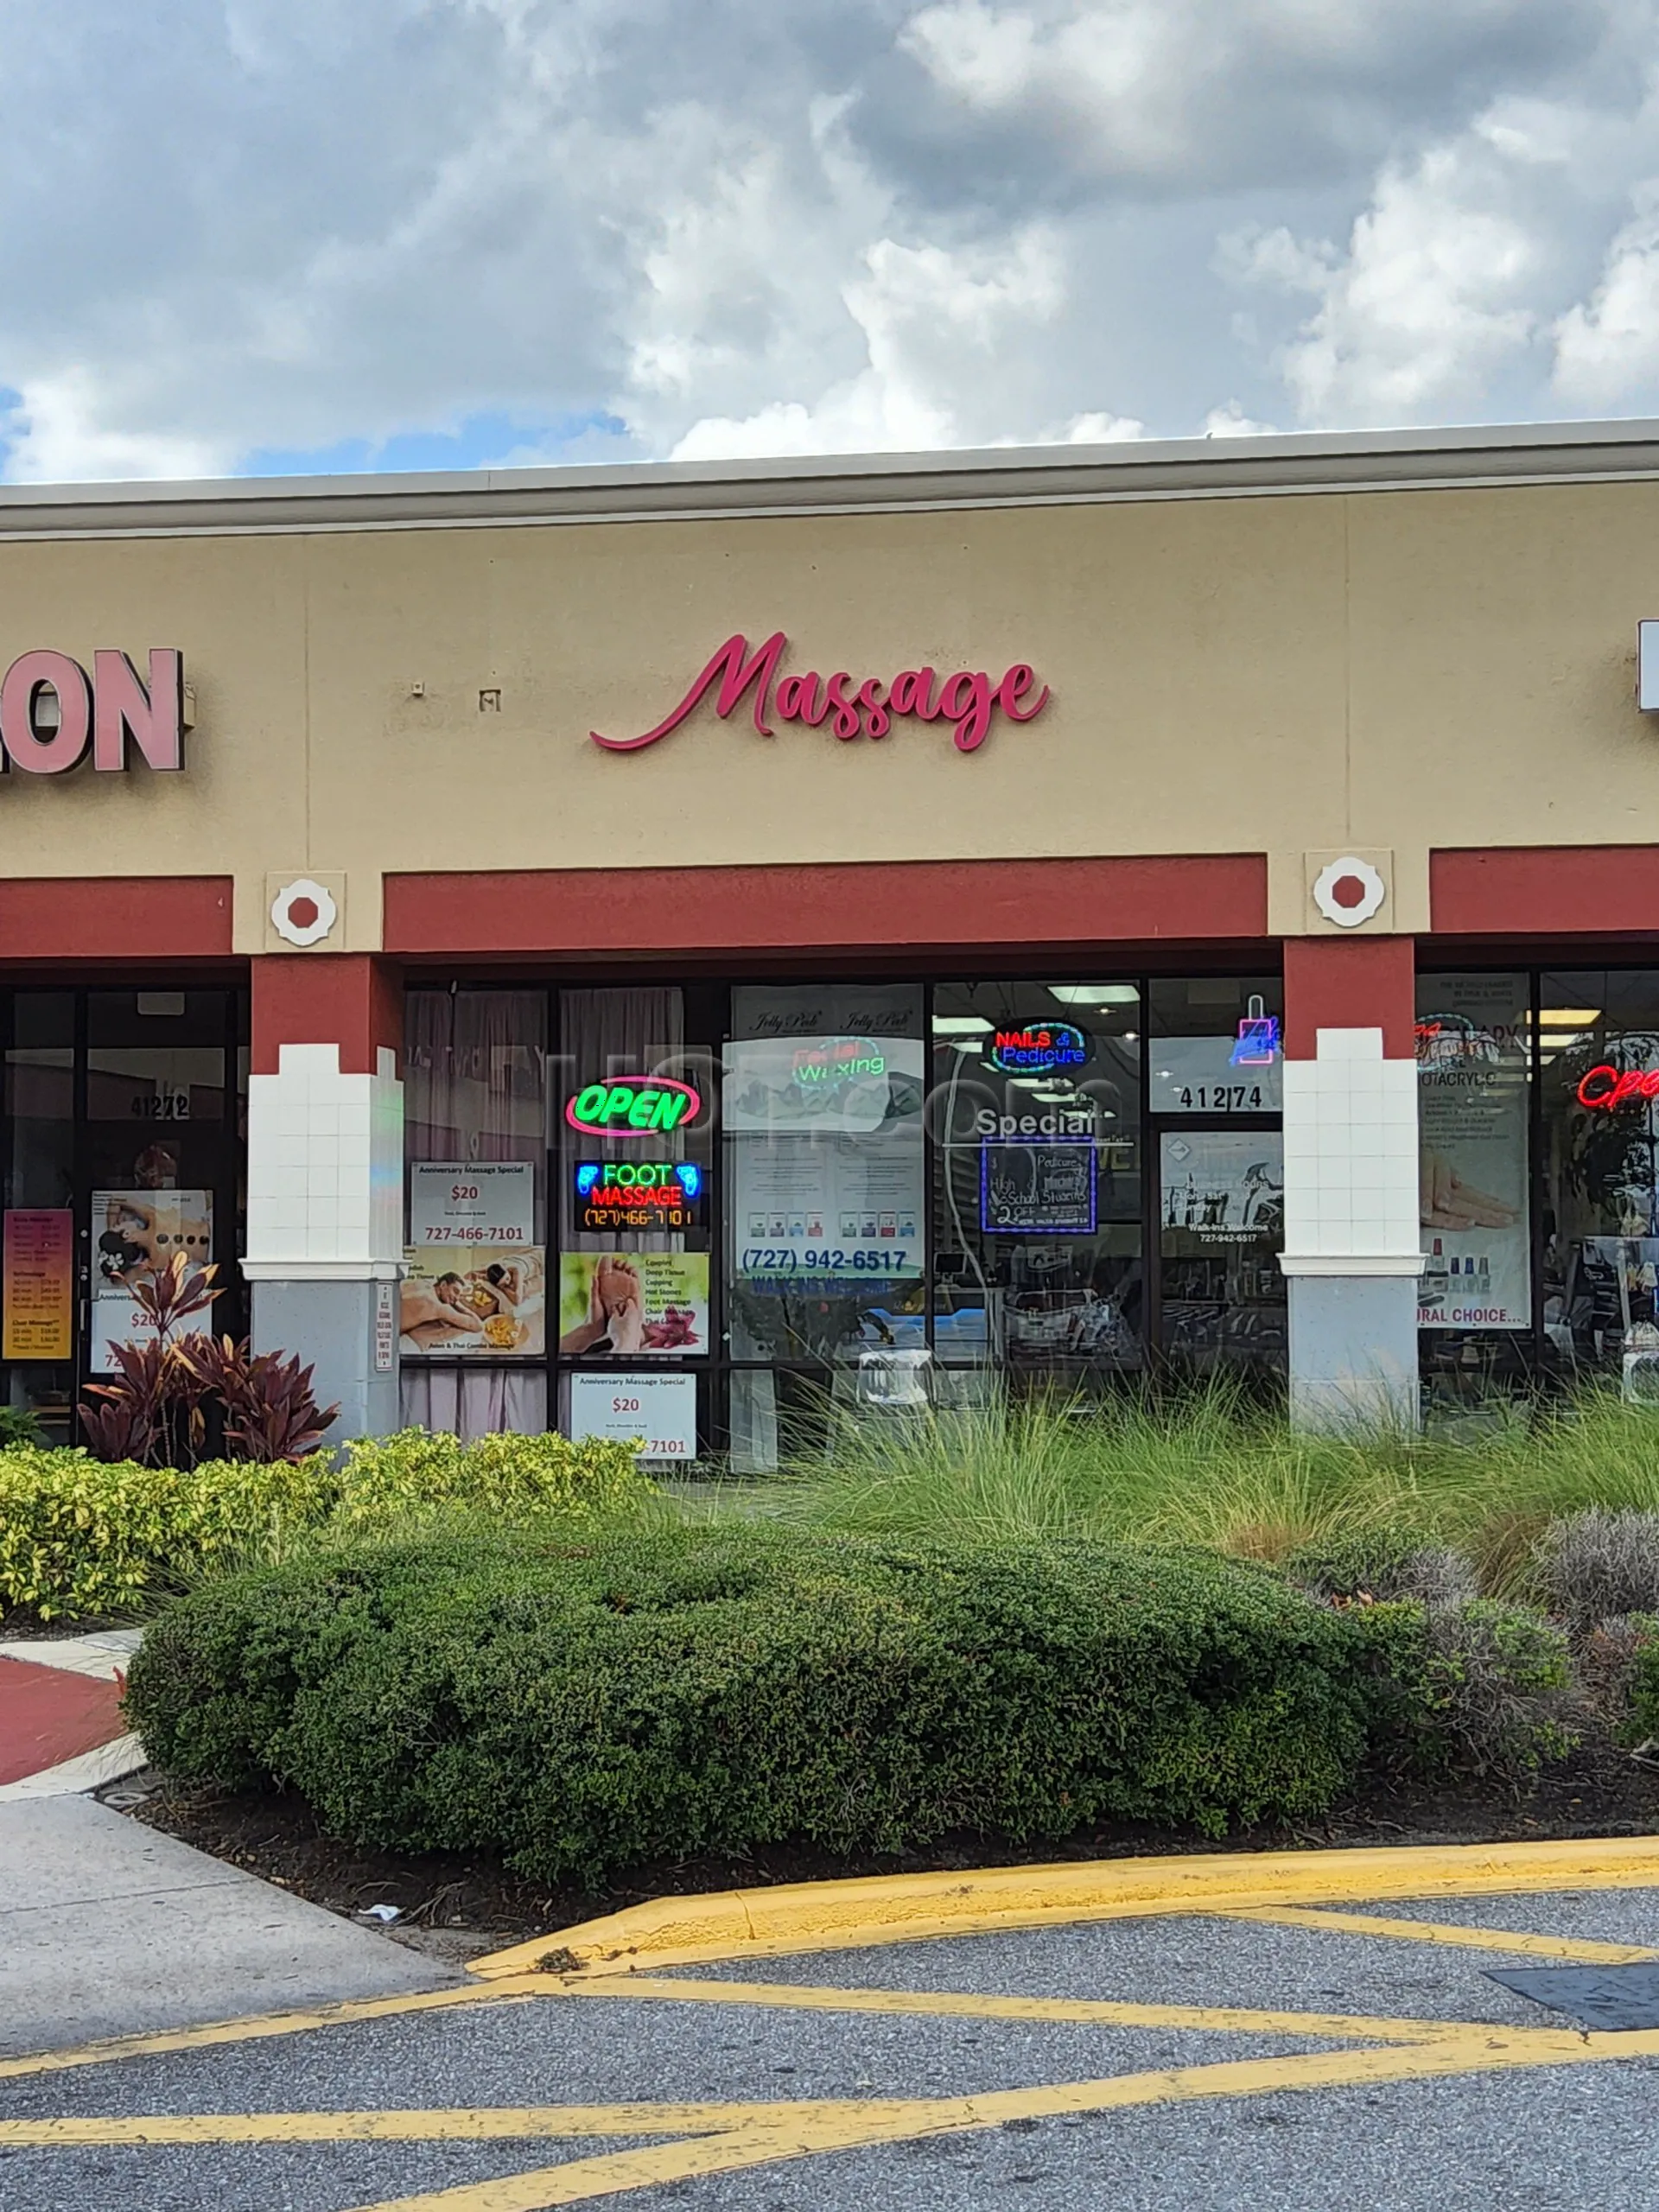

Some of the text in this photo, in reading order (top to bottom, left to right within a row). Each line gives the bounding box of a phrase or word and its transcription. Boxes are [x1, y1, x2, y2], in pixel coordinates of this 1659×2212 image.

[590, 632, 1049, 751] Massage
[996, 1032, 1051, 1047] NAILS
[1002, 1046, 1085, 1063] Pedicure
[1180, 1086, 1262, 1108] 41274
[131, 1096, 188, 1116] 41272
[575, 1084, 686, 1129] OPEN
[976, 1109, 1093, 1140] Special
[419, 1166, 524, 1175] Anniversary Massage Special
[605, 1165, 671, 1185] FOOT
[451, 1185, 478, 1201] $20
[592, 1186, 682, 1205] MASSAGE
[425, 1227, 524, 1240] 727-466-7101
[1200, 1234, 1257, 1243] 727-942-6517
[742, 1249, 906, 1273] (727) 942-6517
[1452, 1308, 1521, 1322] CHOICE...
[580, 1377, 685, 1386] Anniversary Massage Special
[613, 1397, 639, 1413] $20
